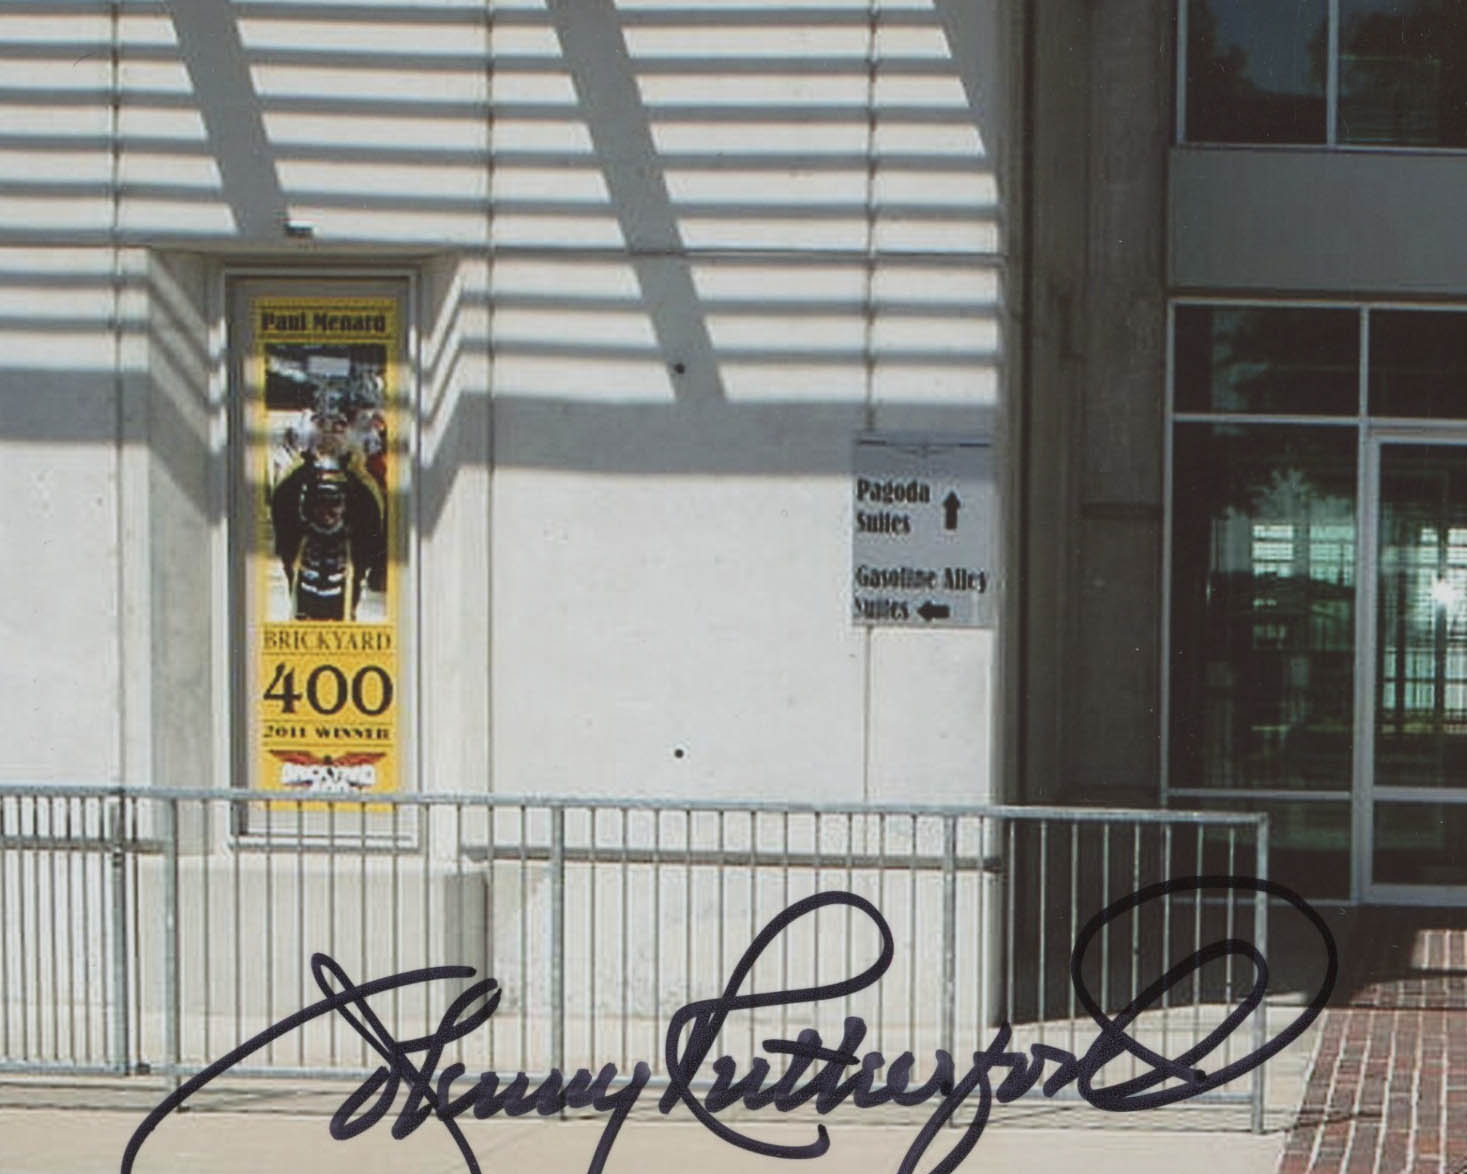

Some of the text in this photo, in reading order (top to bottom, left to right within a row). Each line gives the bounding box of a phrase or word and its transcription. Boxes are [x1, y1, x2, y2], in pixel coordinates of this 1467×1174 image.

[261, 311, 386, 333] Paul Menard
[856, 478, 931, 504] Pagoda
[856, 511, 911, 534] Suites
[855, 565, 987, 594] Gasoline Alley
[854, 598, 909, 620] Suites
[262, 629, 392, 651] BRICKYARD
[263, 662, 394, 717] 400
[262, 724, 391, 741] 2011 WINNER
